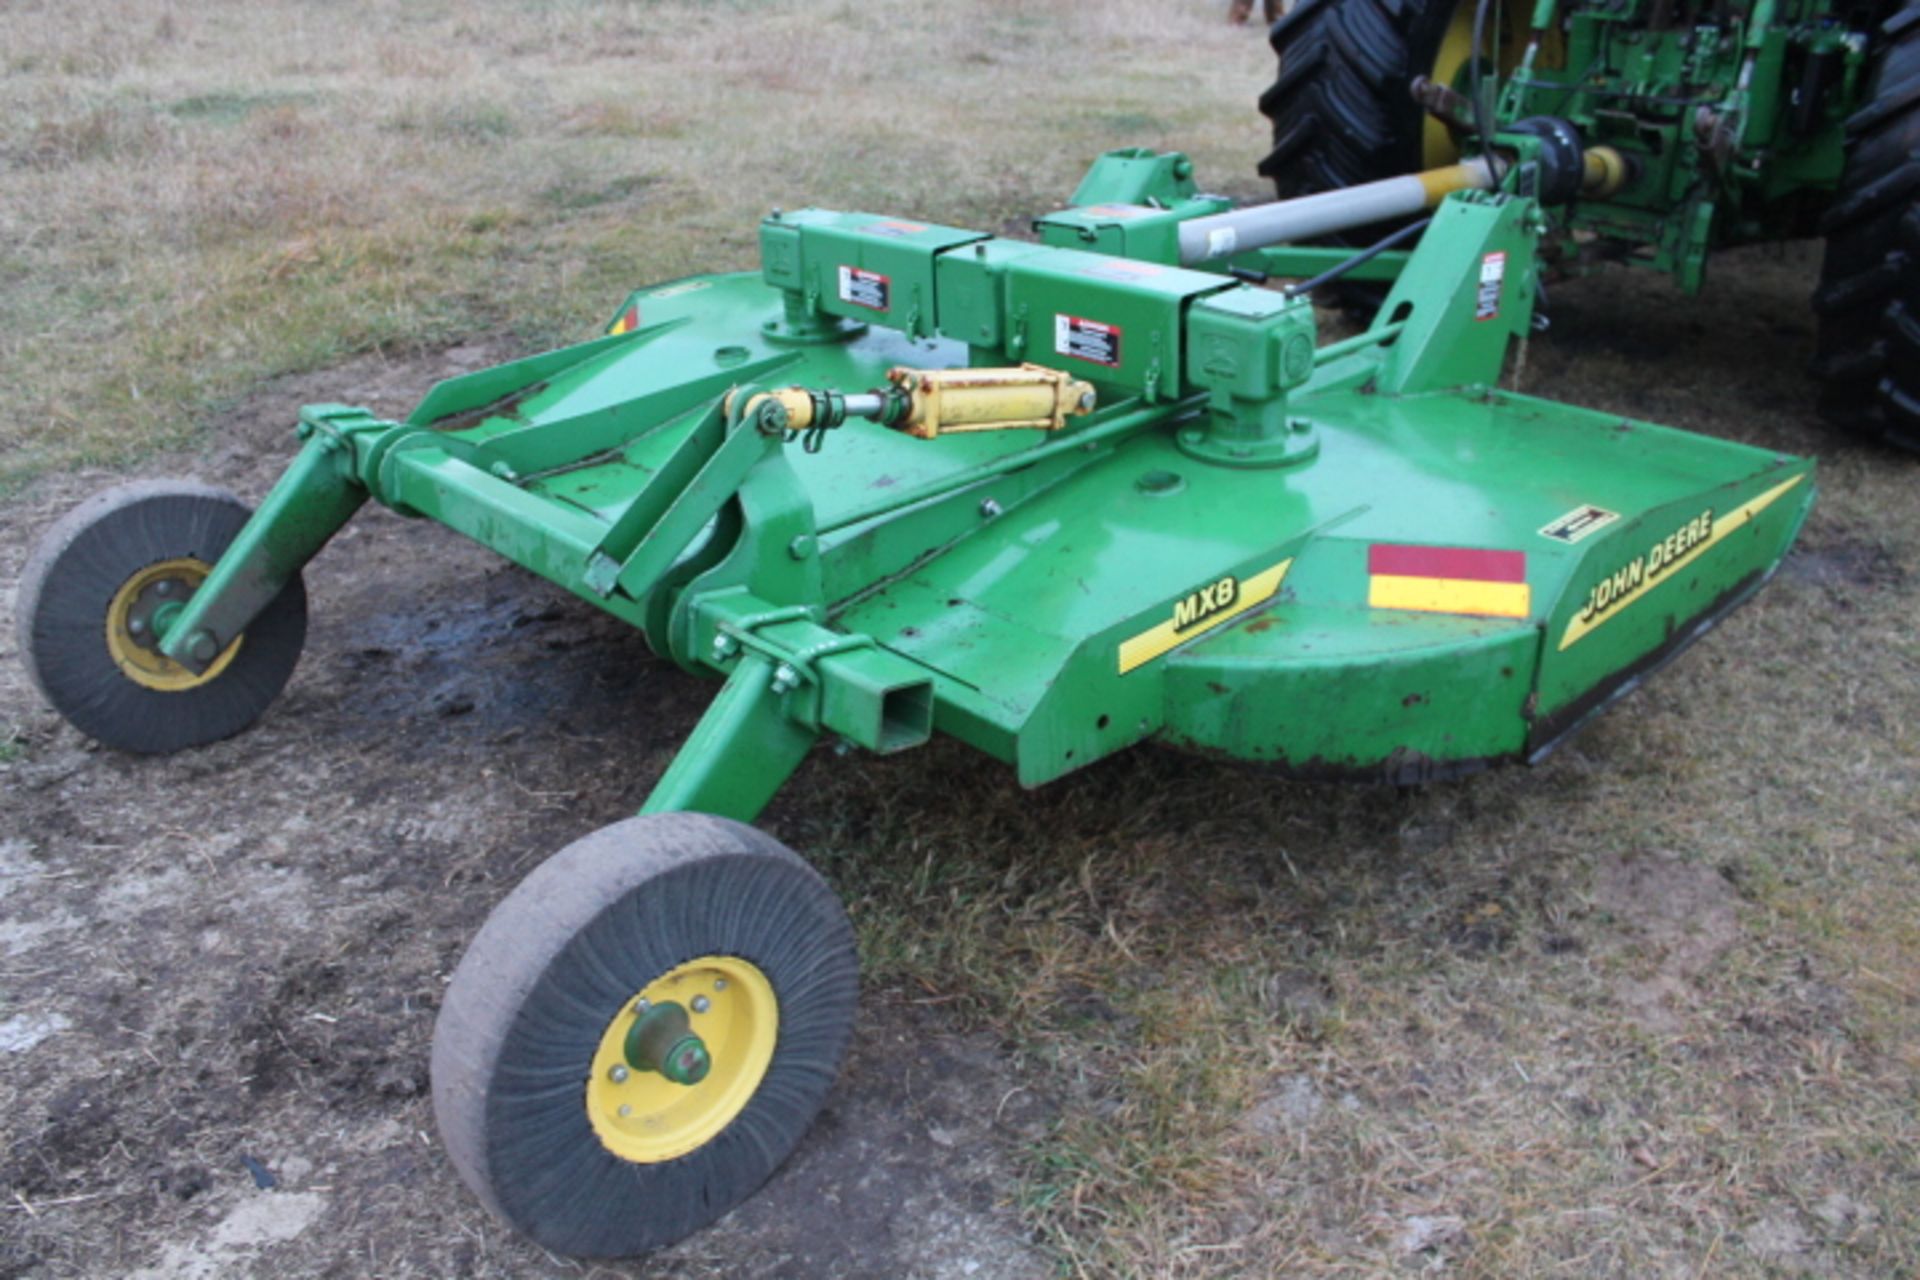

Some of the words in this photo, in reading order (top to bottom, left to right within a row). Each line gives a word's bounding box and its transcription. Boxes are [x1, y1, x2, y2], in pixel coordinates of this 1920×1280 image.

[1173, 576, 1238, 633] MX8
[1581, 556, 1644, 622] JOHN
[1645, 508, 1713, 578] DEERE
